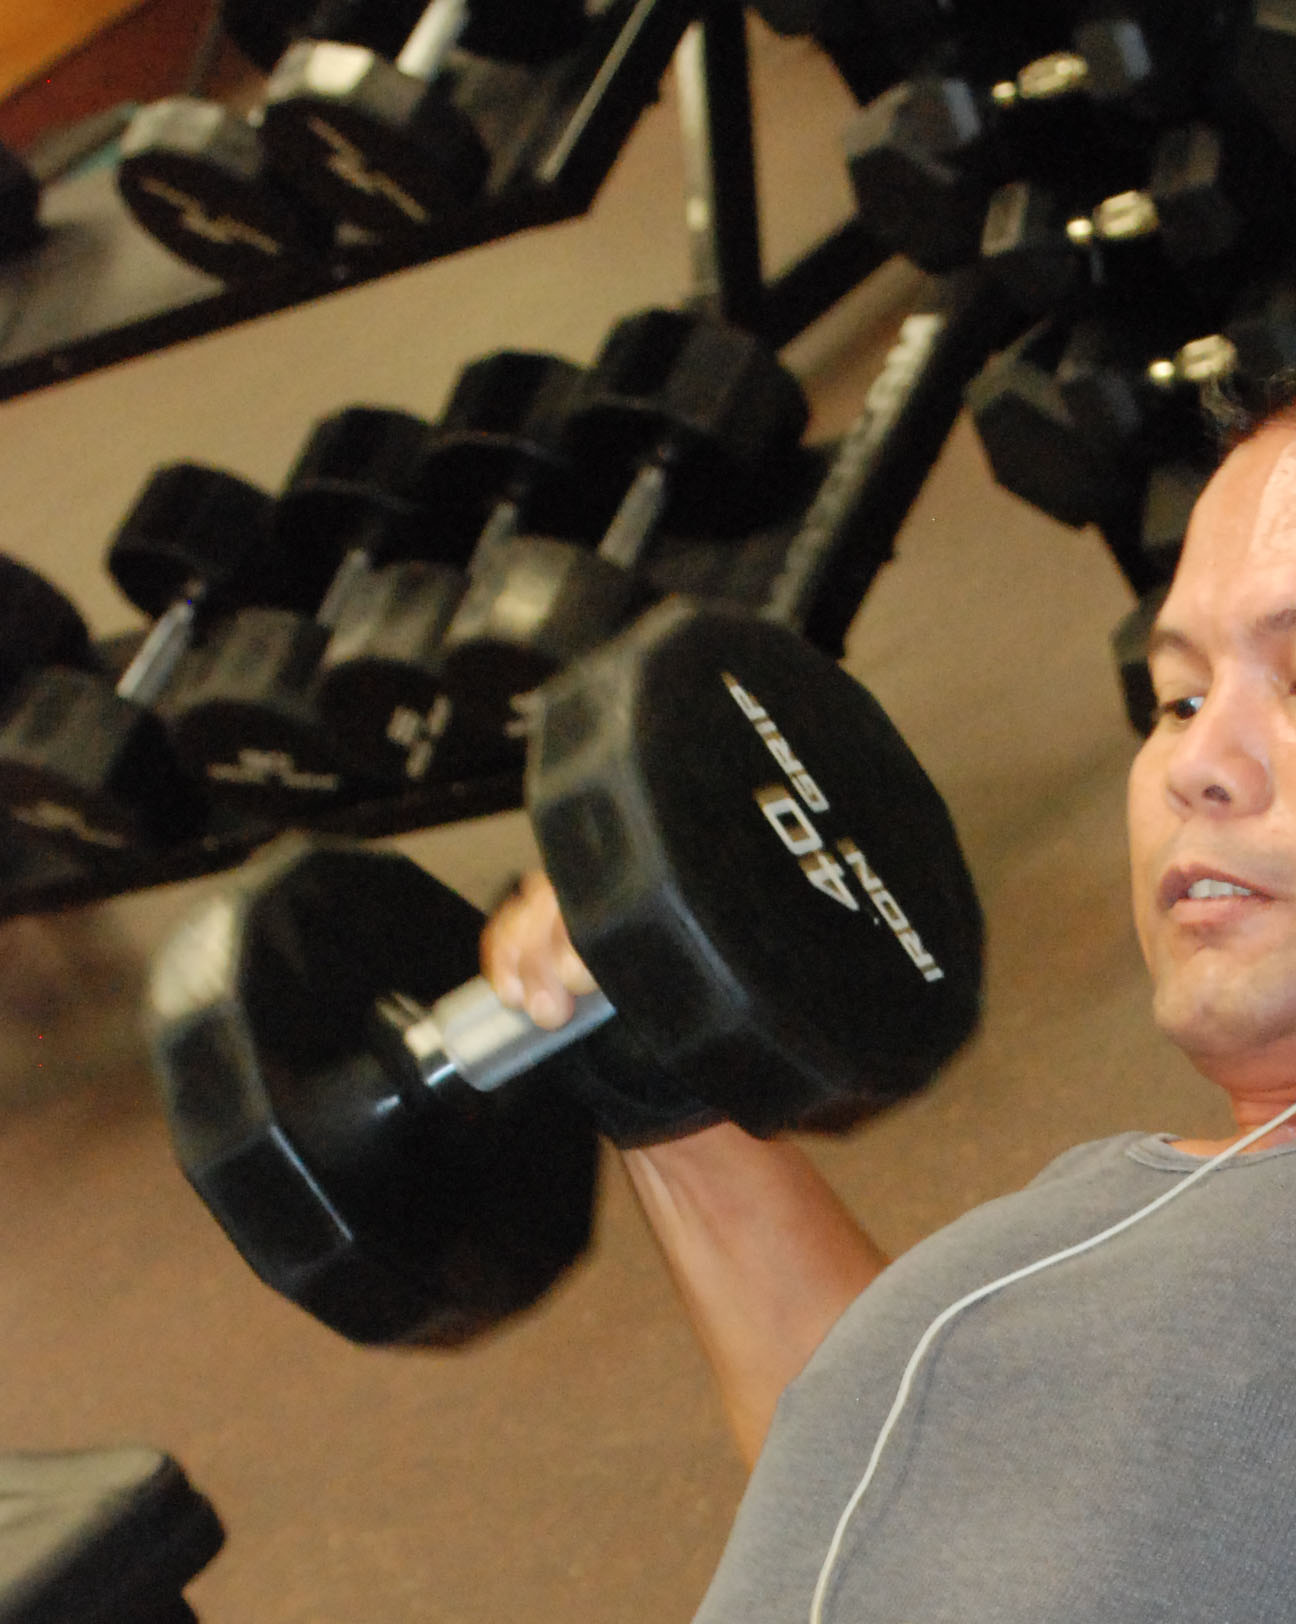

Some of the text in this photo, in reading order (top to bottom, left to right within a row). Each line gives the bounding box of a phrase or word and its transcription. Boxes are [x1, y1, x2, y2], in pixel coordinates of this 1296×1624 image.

[729, 684, 944, 982] IRON GRIP
[762, 797, 859, 910] 40
